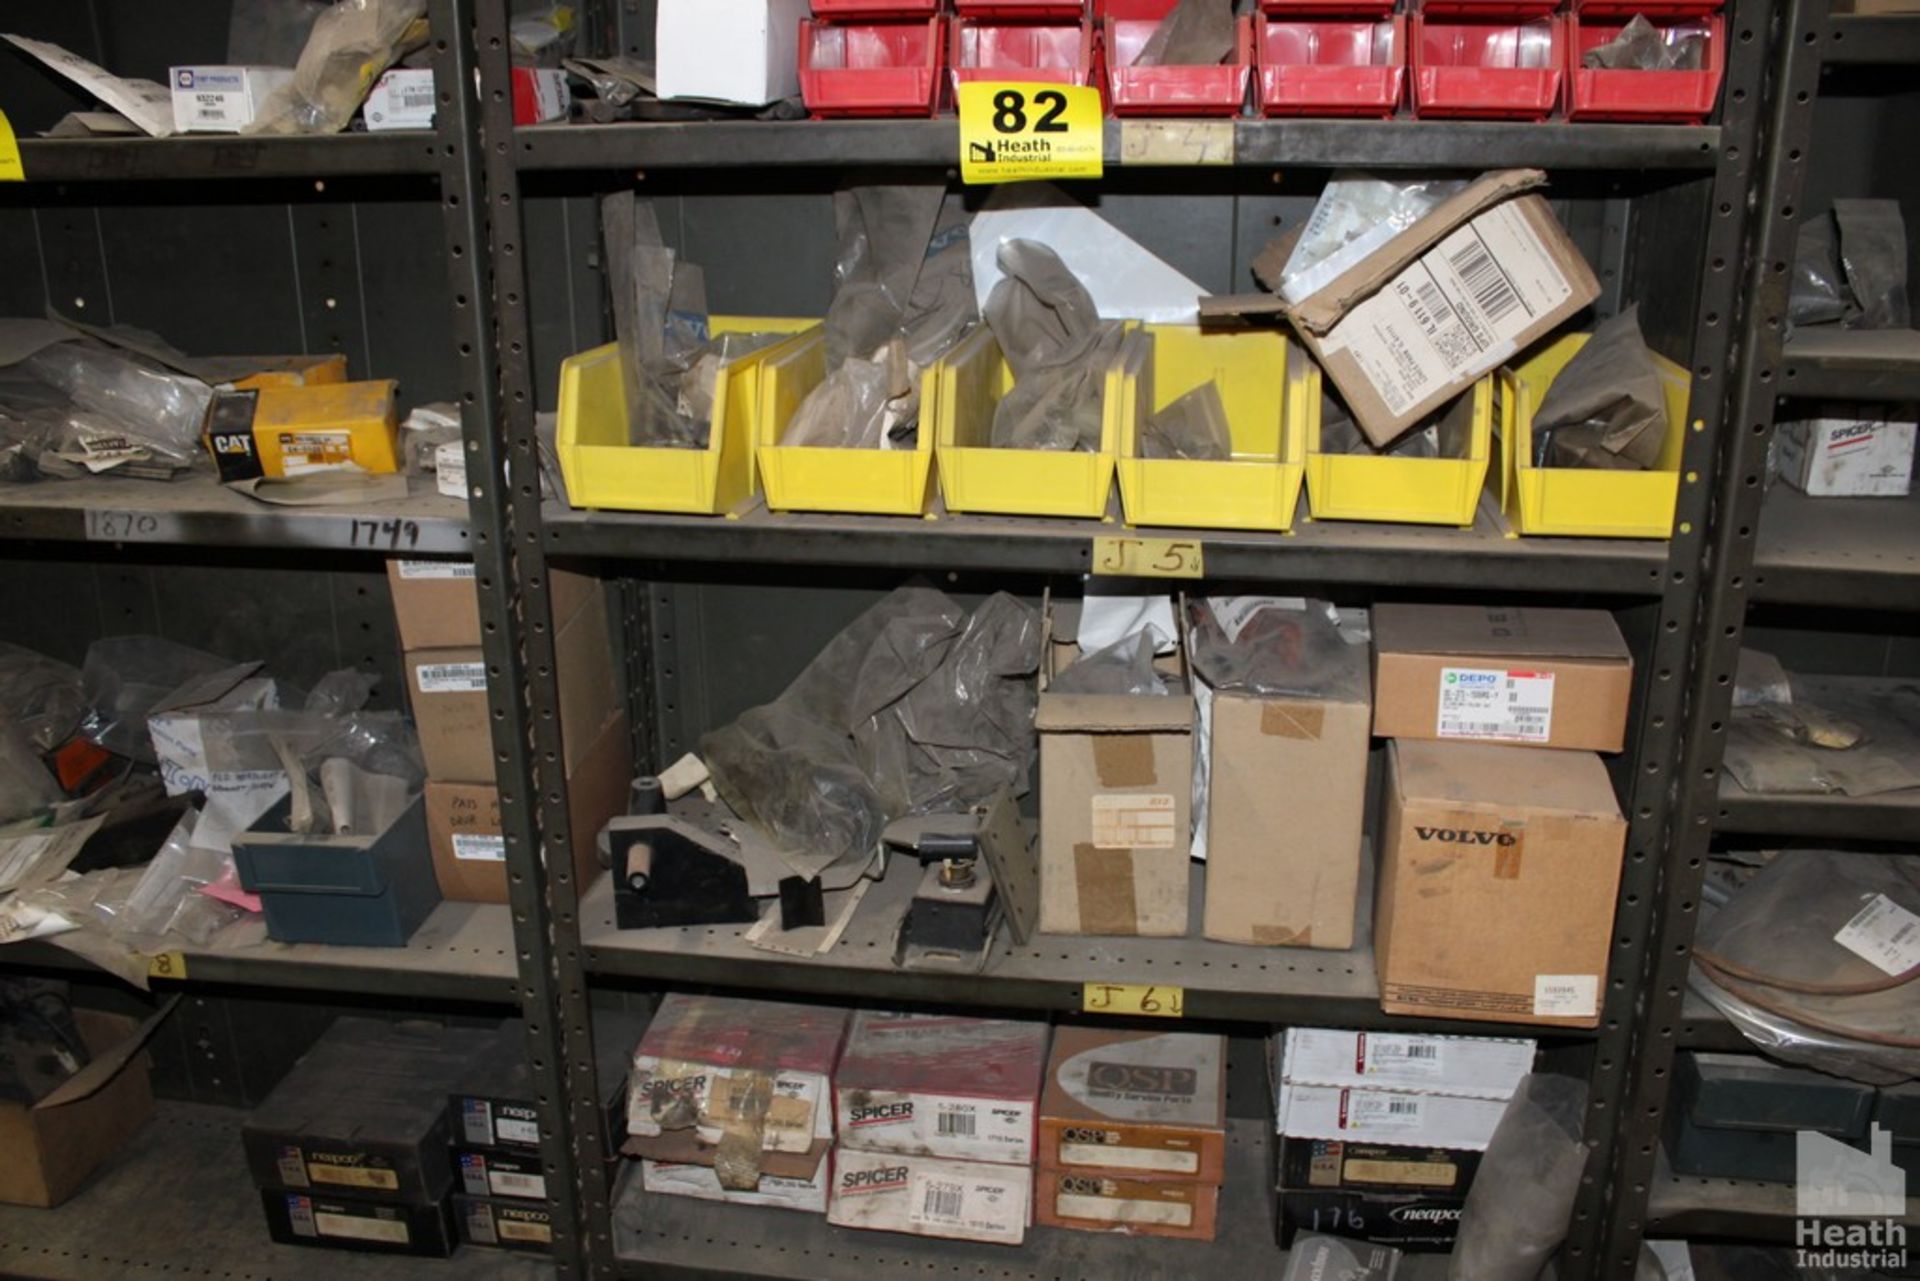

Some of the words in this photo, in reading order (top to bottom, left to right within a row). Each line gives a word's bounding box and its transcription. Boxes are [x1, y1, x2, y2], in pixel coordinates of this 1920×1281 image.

[992, 90, 1069, 133] 82
[997, 138, 1051, 152] Heath
[997, 153, 1051, 163] Industrial
[1454, 300, 1480, 333] GROUND
[214, 434, 250, 453] CAT
[349, 518, 420, 547] 1749
[1102, 539, 1144, 572] J
[1152, 543, 1195, 572] 5
[1459, 673, 1497, 684] DEPO
[1414, 826, 1517, 847] VOLVO
[1090, 985, 1125, 1008] J
[1139, 986, 1161, 1012] 6
[642, 1075, 706, 1095] SPICER
[1093, 1063, 1193, 1090] QSP
[1088, 1088, 1121, 1100] Quality
[1123, 1091, 1161, 1102] Service
[1163, 1095, 1192, 1104] Parts
[503, 1105, 538, 1120] neap
[851, 1101, 914, 1122] SPICER
[991, 1108, 1022, 1117] SPICER
[841, 1166, 910, 1188] SPICER
[974, 1185, 1005, 1195] SPICER
[1312, 1207, 1364, 1231] 176
